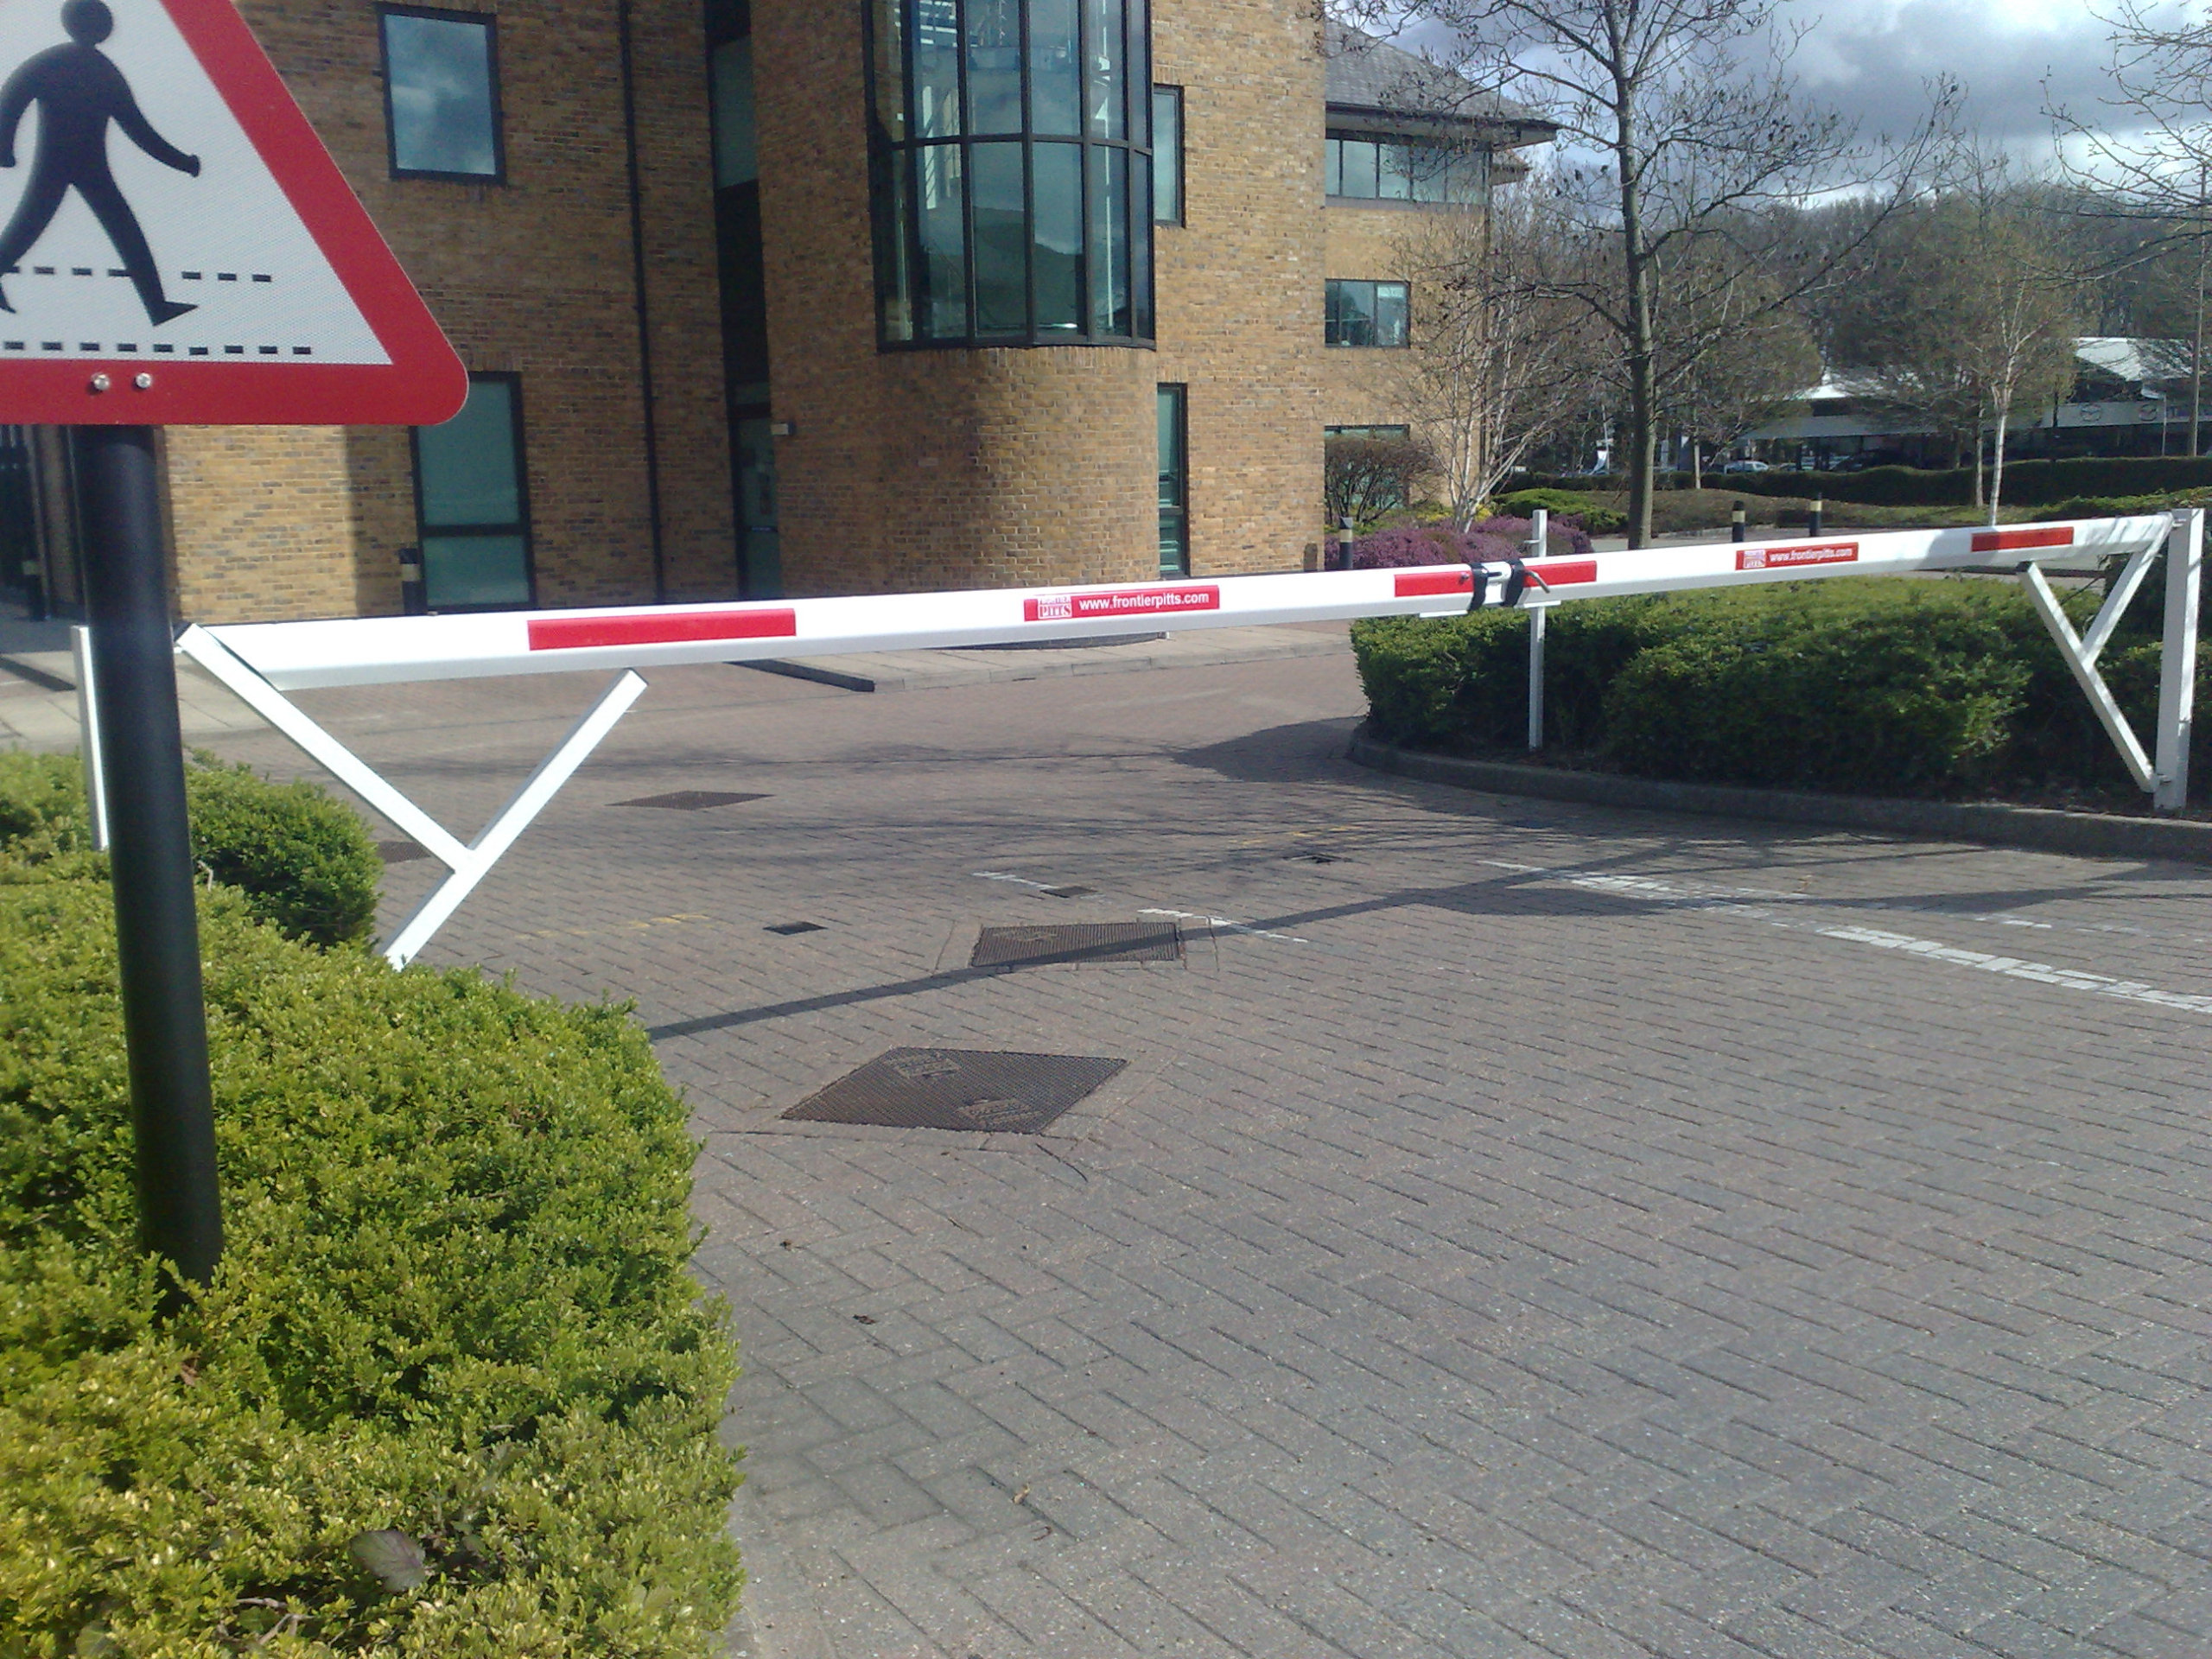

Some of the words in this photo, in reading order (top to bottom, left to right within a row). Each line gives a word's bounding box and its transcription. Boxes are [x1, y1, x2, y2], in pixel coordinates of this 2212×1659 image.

[1769, 548, 1852, 562] www.frontierpitts.com
[1078, 592, 1210, 611] www.frontierpitts.com
[1039, 605, 1071, 617] PITTS
